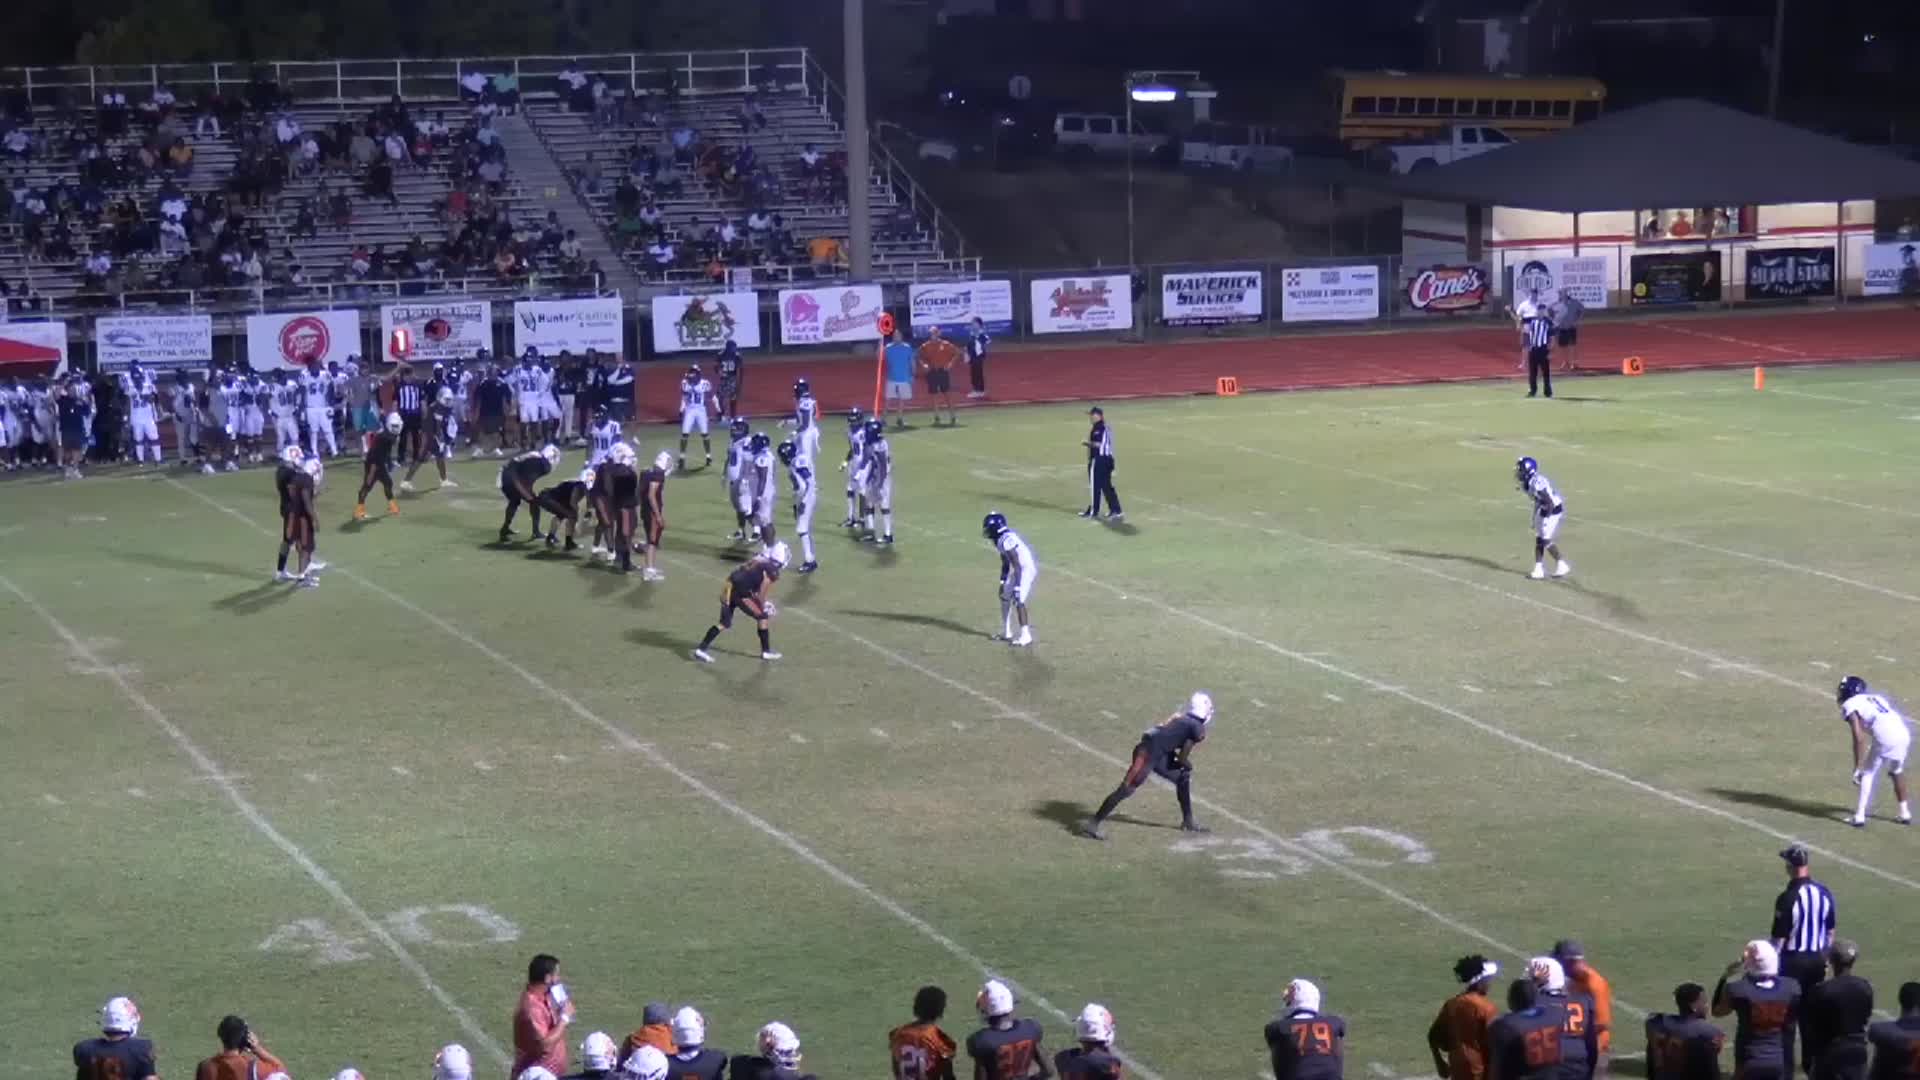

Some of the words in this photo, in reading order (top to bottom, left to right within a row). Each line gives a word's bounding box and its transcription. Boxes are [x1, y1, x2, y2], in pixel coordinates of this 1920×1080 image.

[1798, 264, 1830, 281] STAR
[1166, 276, 1258, 291] MAVERICK
[1411, 269, 1481, 308] Cane's
[1176, 291, 1245, 305] SERVICES
[538, 313, 575, 323] Hunter
[395, 330, 405, 352] 1
[1629, 358, 1640, 372] G
[1220, 379, 1235, 393] 10
[1562, 1001, 1585, 1034] 2
[1290, 1022, 1332, 1056] 79
